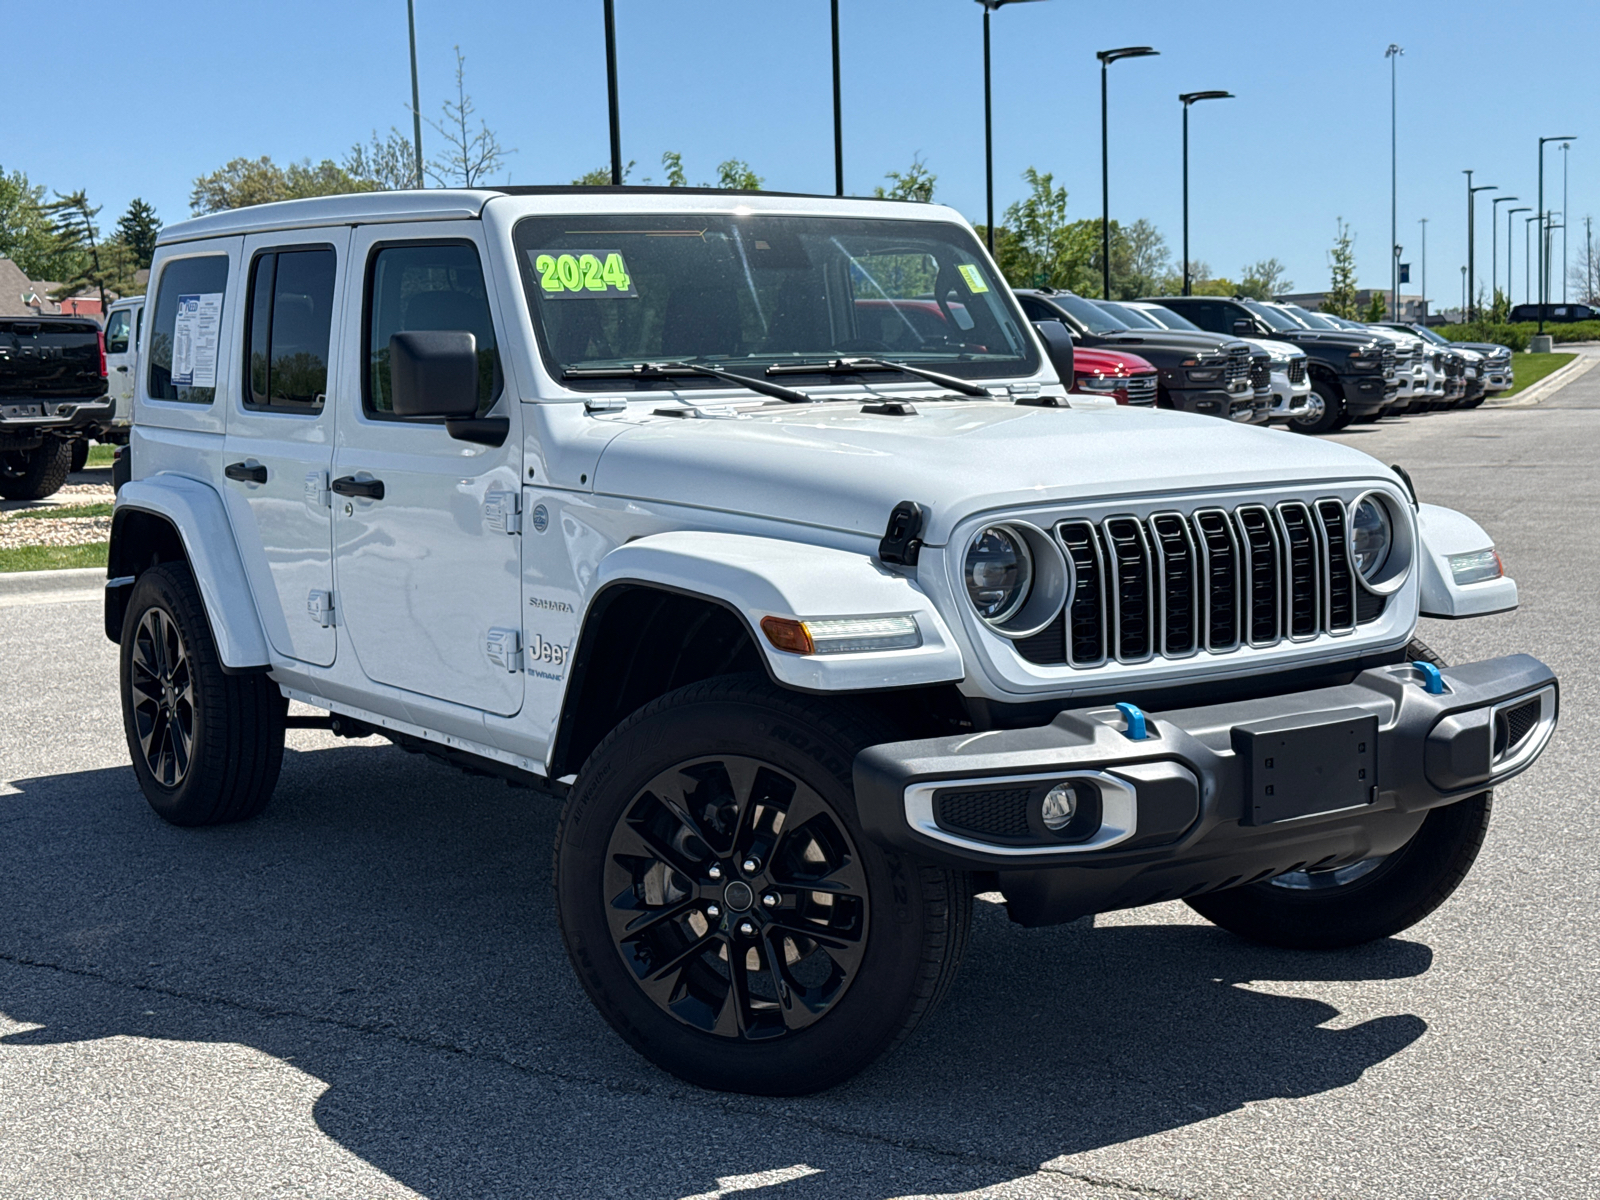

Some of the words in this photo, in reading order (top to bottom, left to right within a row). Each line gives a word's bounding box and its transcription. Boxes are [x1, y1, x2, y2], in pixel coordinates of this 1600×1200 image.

[536, 253, 630, 292] 2024
[529, 597, 574, 613] SAHARA
[535, 669, 565, 681] WRANG
[768, 724, 853, 790] ROADI
[573, 760, 612, 826] All-Weather
